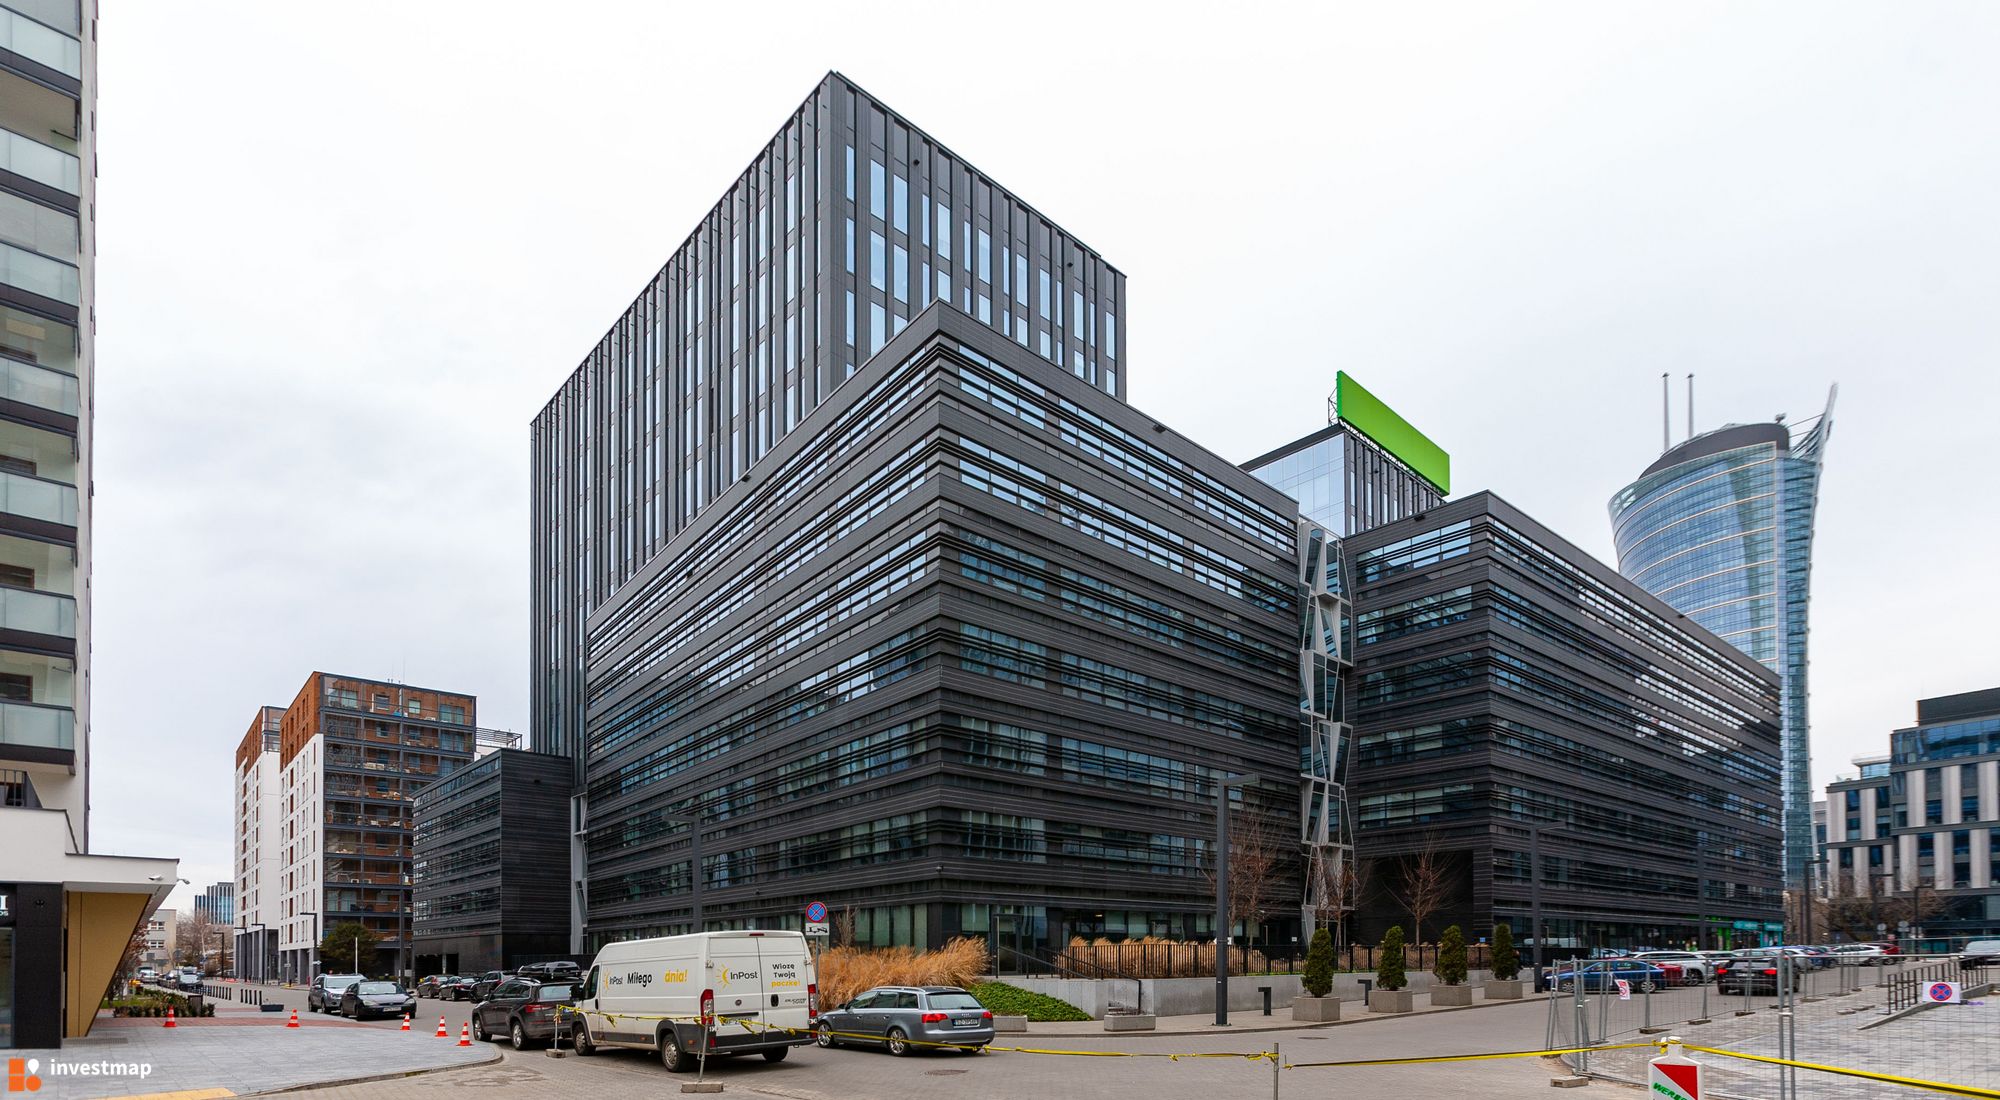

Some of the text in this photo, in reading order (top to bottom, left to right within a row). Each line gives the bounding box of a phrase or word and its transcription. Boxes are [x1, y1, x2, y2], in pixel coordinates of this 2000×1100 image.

[627, 968, 688, 987] Miłego dnia!
[730, 971, 758, 980] InPost
[773, 971, 796, 979] Twoją
[609, 976, 623, 985] InPost
